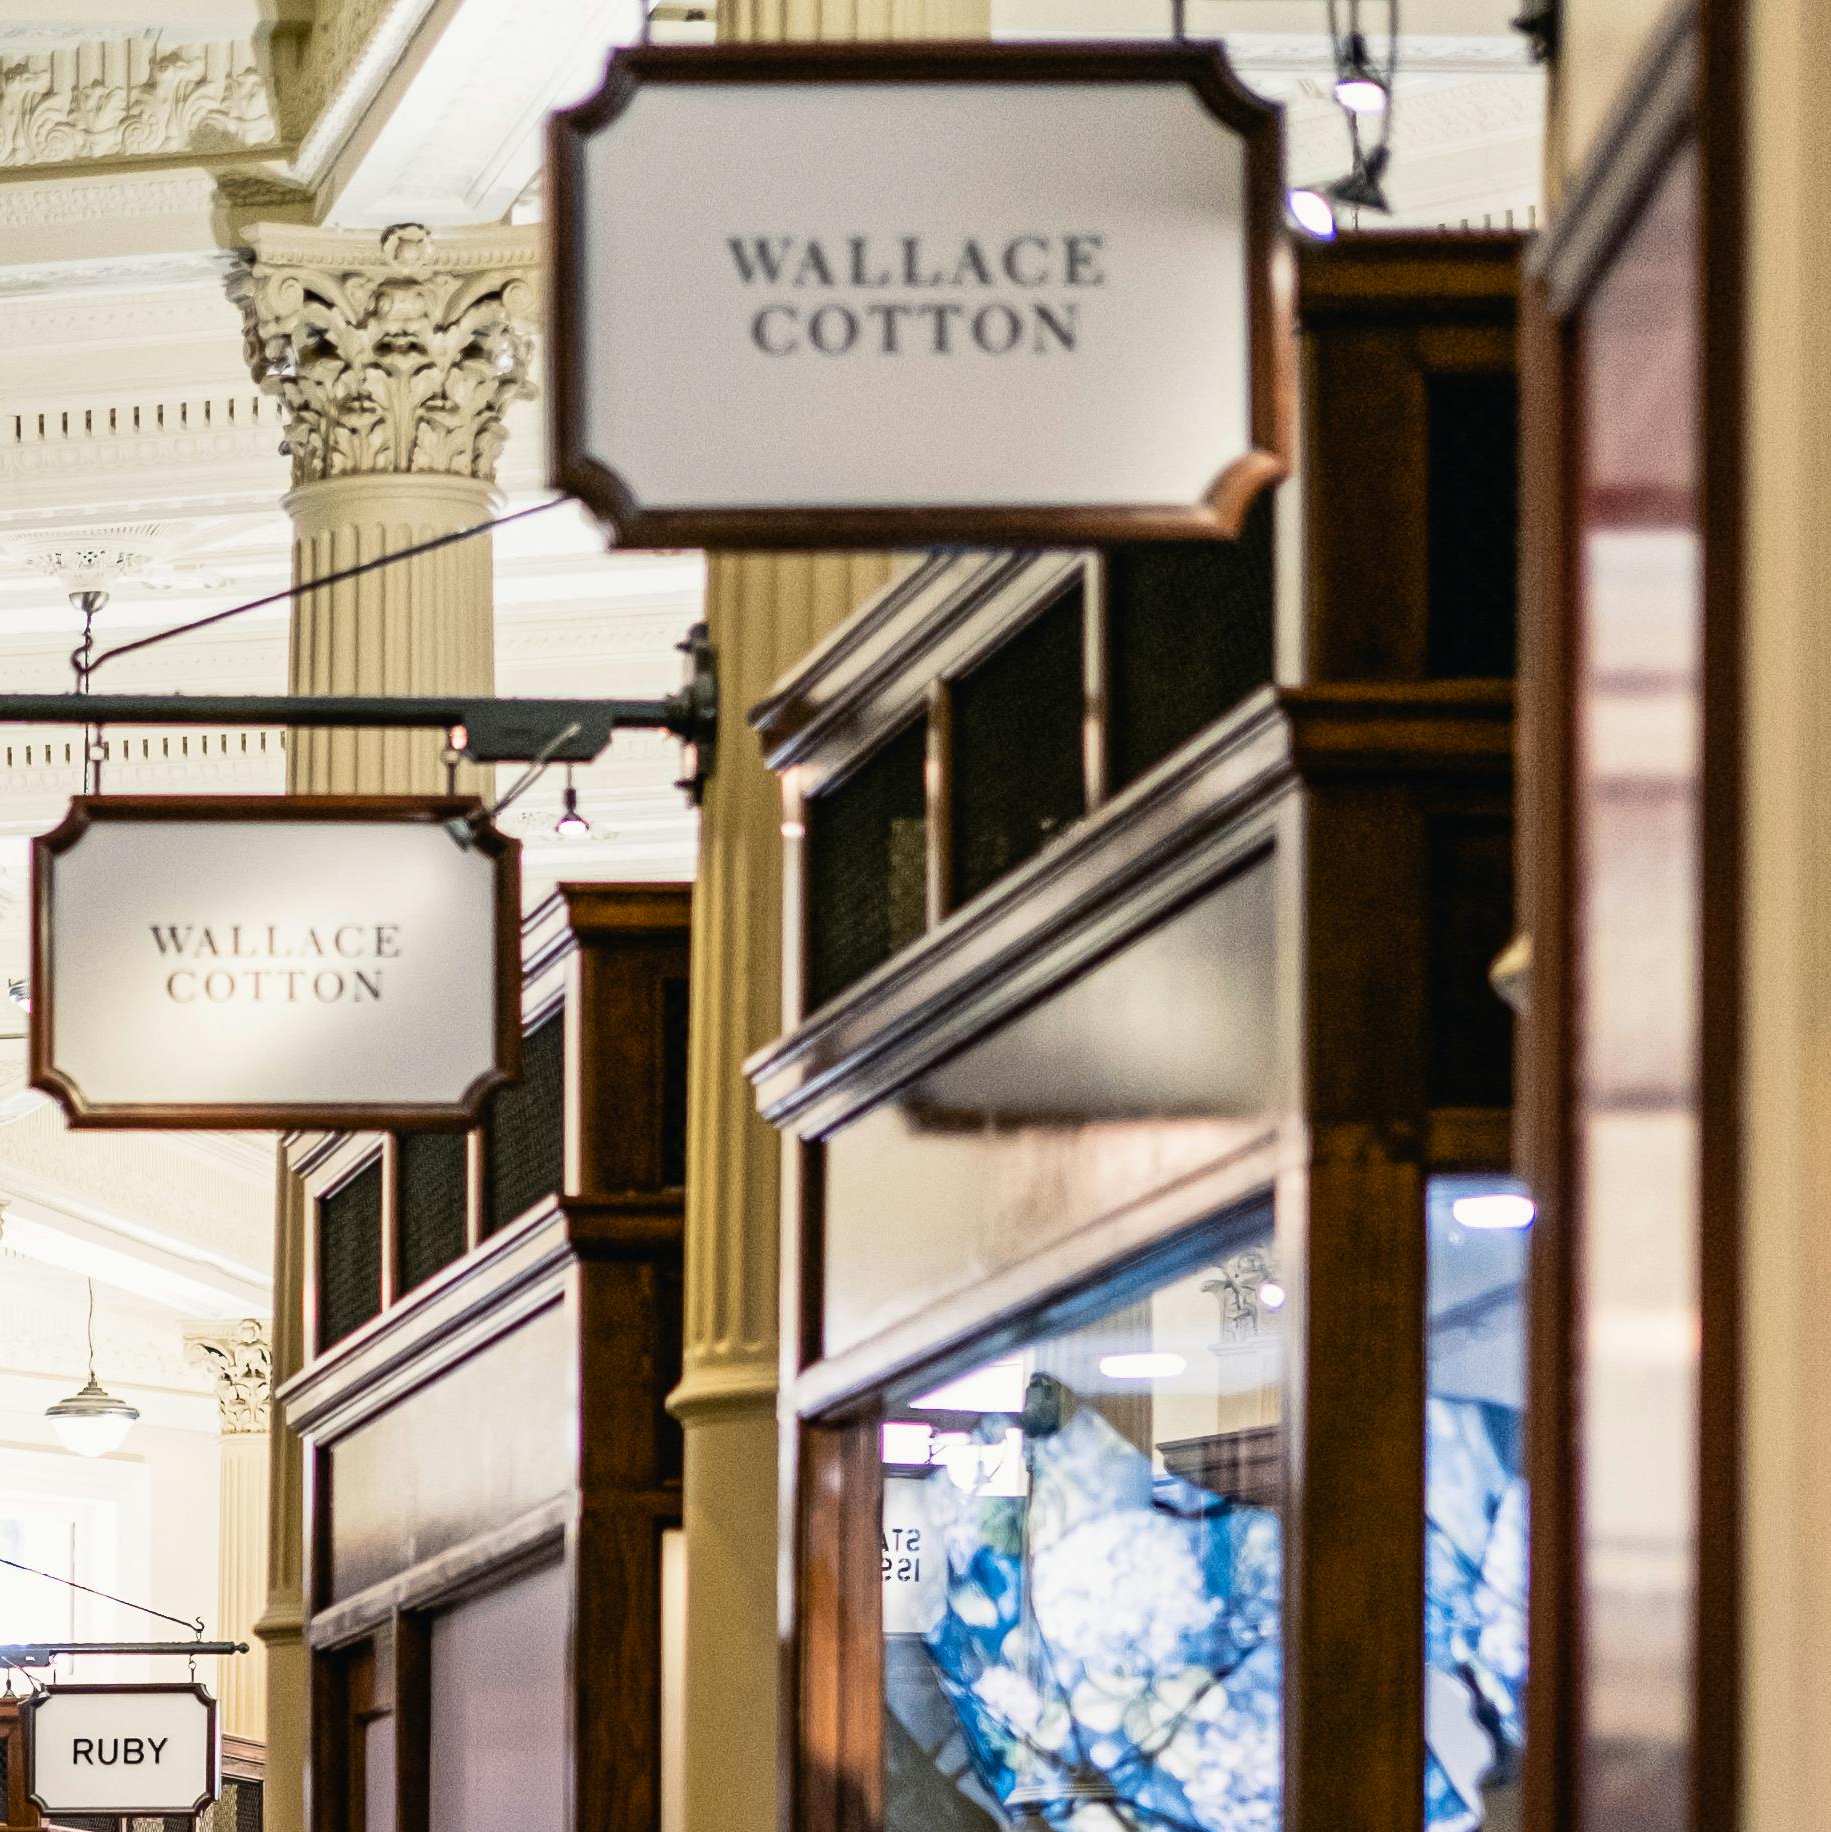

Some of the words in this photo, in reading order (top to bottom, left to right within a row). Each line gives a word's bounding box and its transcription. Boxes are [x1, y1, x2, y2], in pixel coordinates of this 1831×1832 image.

[727, 236, 1106, 288] WALLACE
[750, 302, 1079, 355] COTTON
[150, 924, 402, 958] WALLACE
[167, 969, 383, 1003] COTTON
[73, 1737, 169, 1766] RUBY
